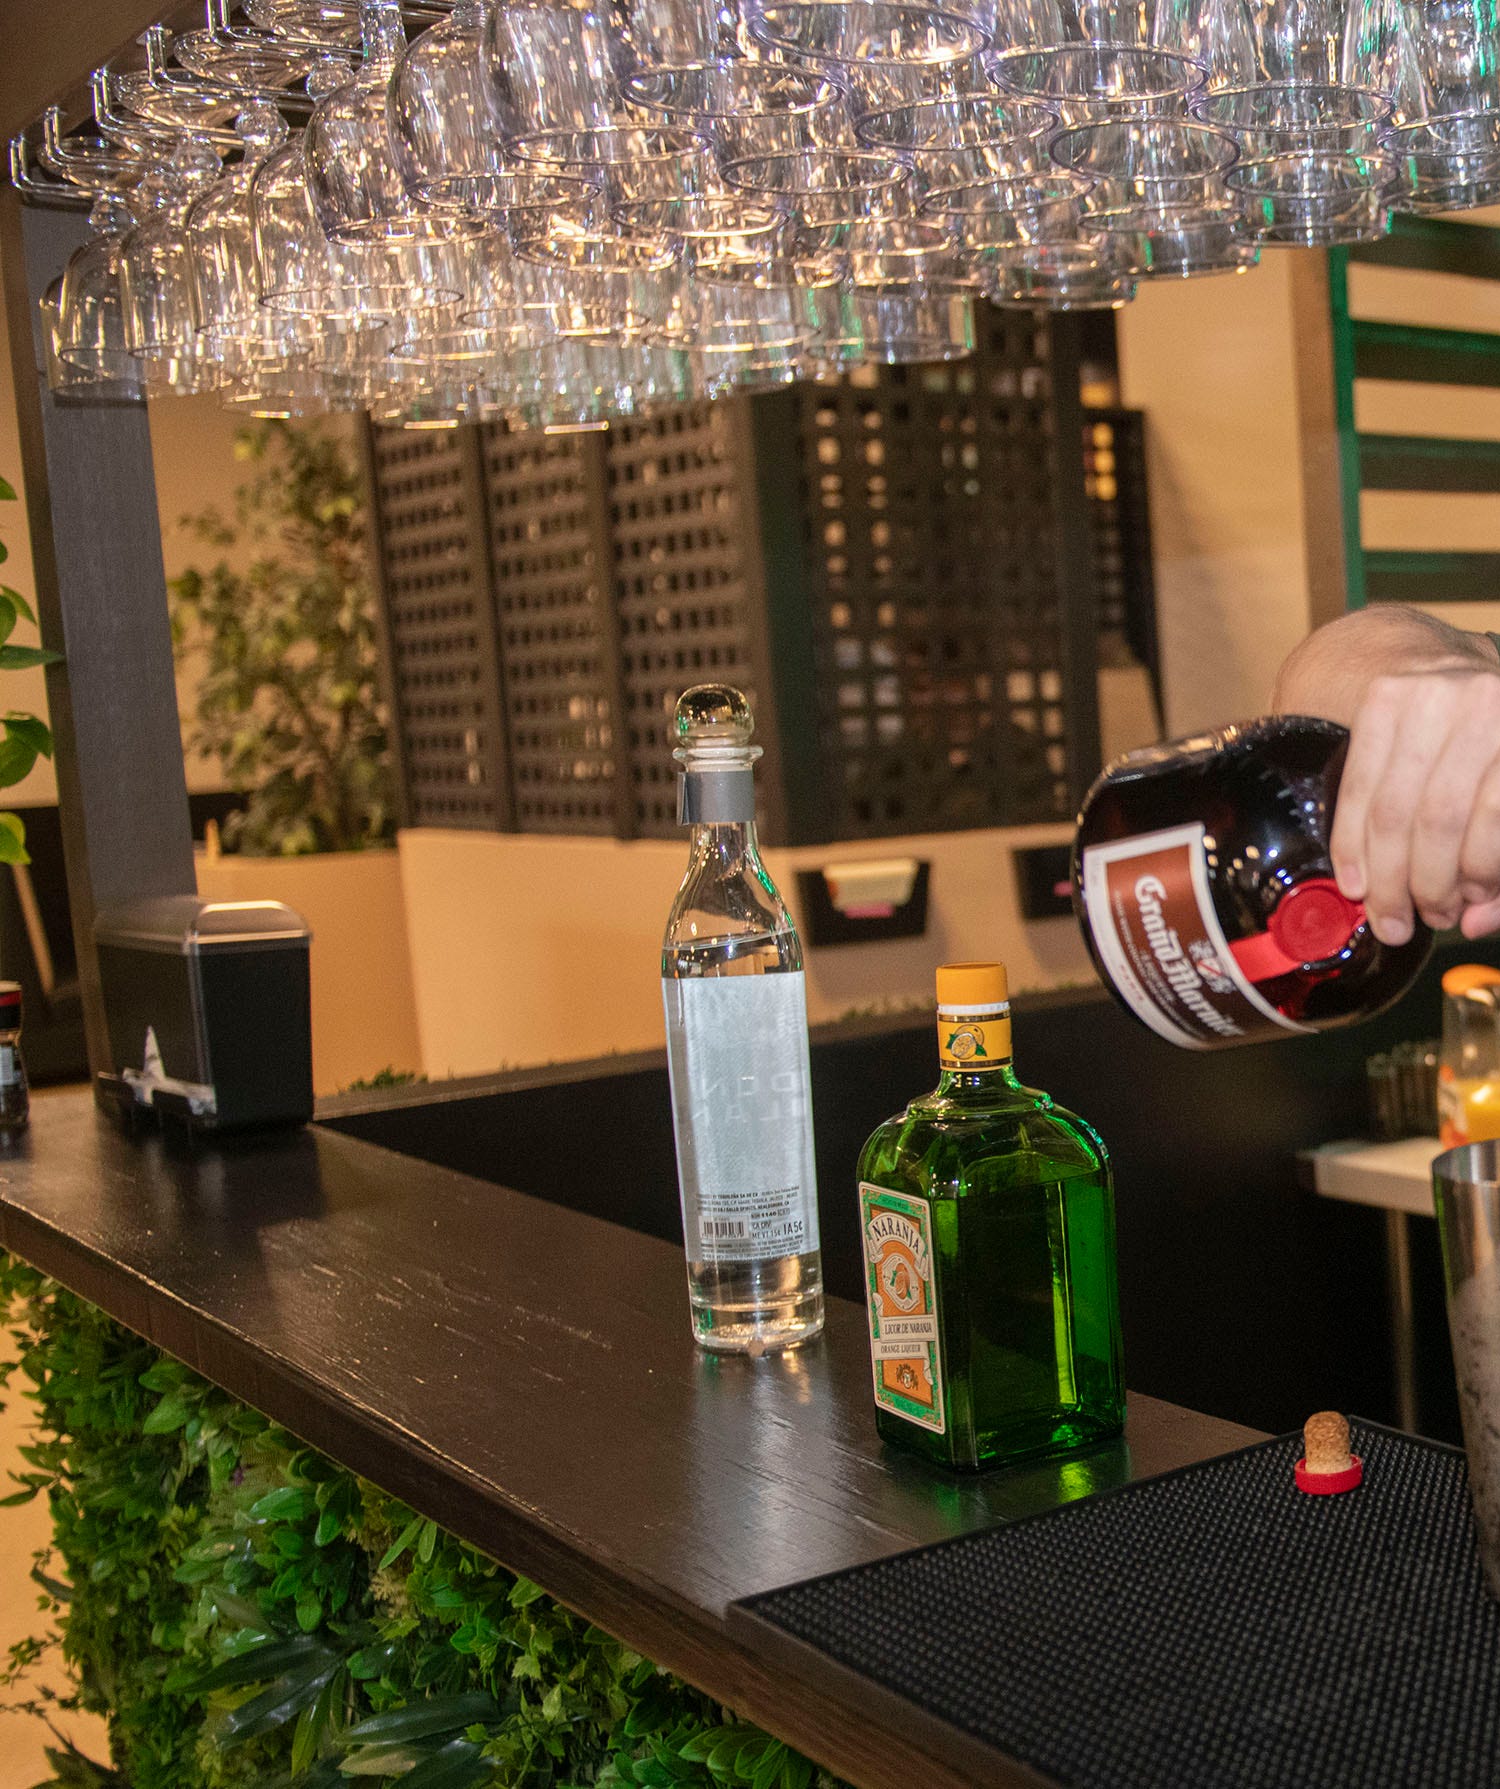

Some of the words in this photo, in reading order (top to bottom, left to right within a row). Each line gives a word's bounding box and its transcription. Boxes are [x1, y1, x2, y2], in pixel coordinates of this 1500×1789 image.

[1134, 873, 1185, 962] Grand
[1160, 955, 1247, 1037] Marnier
[872, 1217, 919, 1254] NARANJA
[902, 1323, 909, 1334] DE
[910, 1322, 933, 1333] NARANJA
